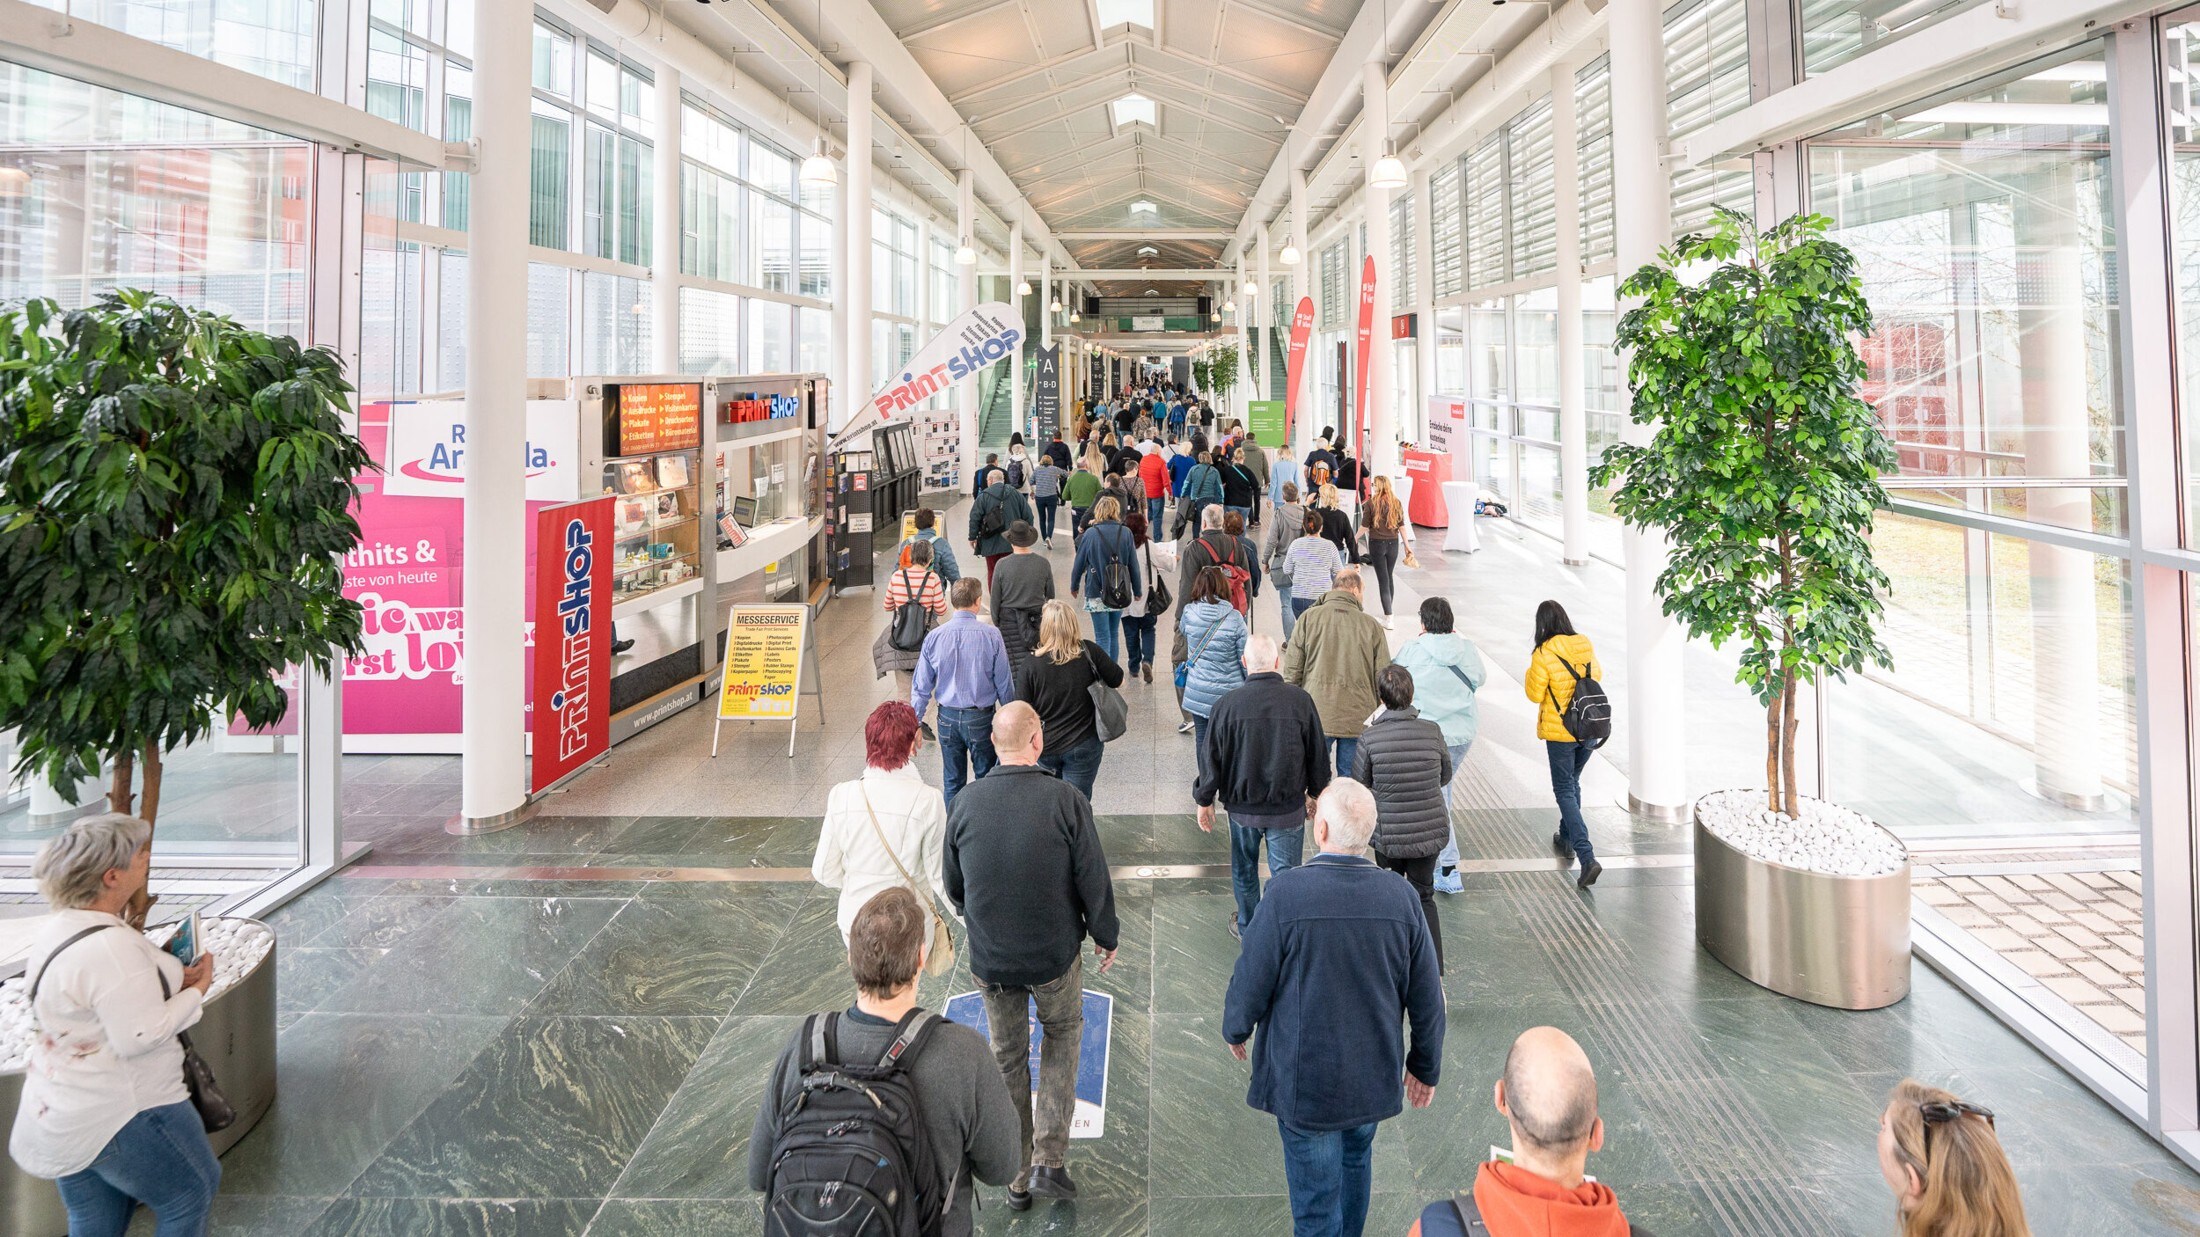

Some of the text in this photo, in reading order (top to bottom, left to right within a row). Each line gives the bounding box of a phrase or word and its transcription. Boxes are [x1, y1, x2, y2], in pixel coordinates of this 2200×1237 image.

[972, 310, 999, 335] Visitenkarten
[991, 316, 1006, 331] Kopien
[965, 325, 984, 342] Stempel
[975, 323, 991, 338] Plakate
[1043, 358, 1054, 374] A
[628, 394, 648, 404] Kopien
[664, 392, 686, 402] Stempel
[628, 406, 656, 415] Ausdrucke
[664, 404, 698, 413] Visitenkarten
[629, 419, 650, 428] Plakate
[629, 431, 655, 441] Etiketten
[665, 426, 698, 437] Büromaterial
[415, 539, 437, 563] &
[369, 574, 394, 586] von
[398, 570, 438, 584] heute
[736, 615, 800, 624] MESSESERVICE
[633, 691, 693, 728] www.printshop.at
